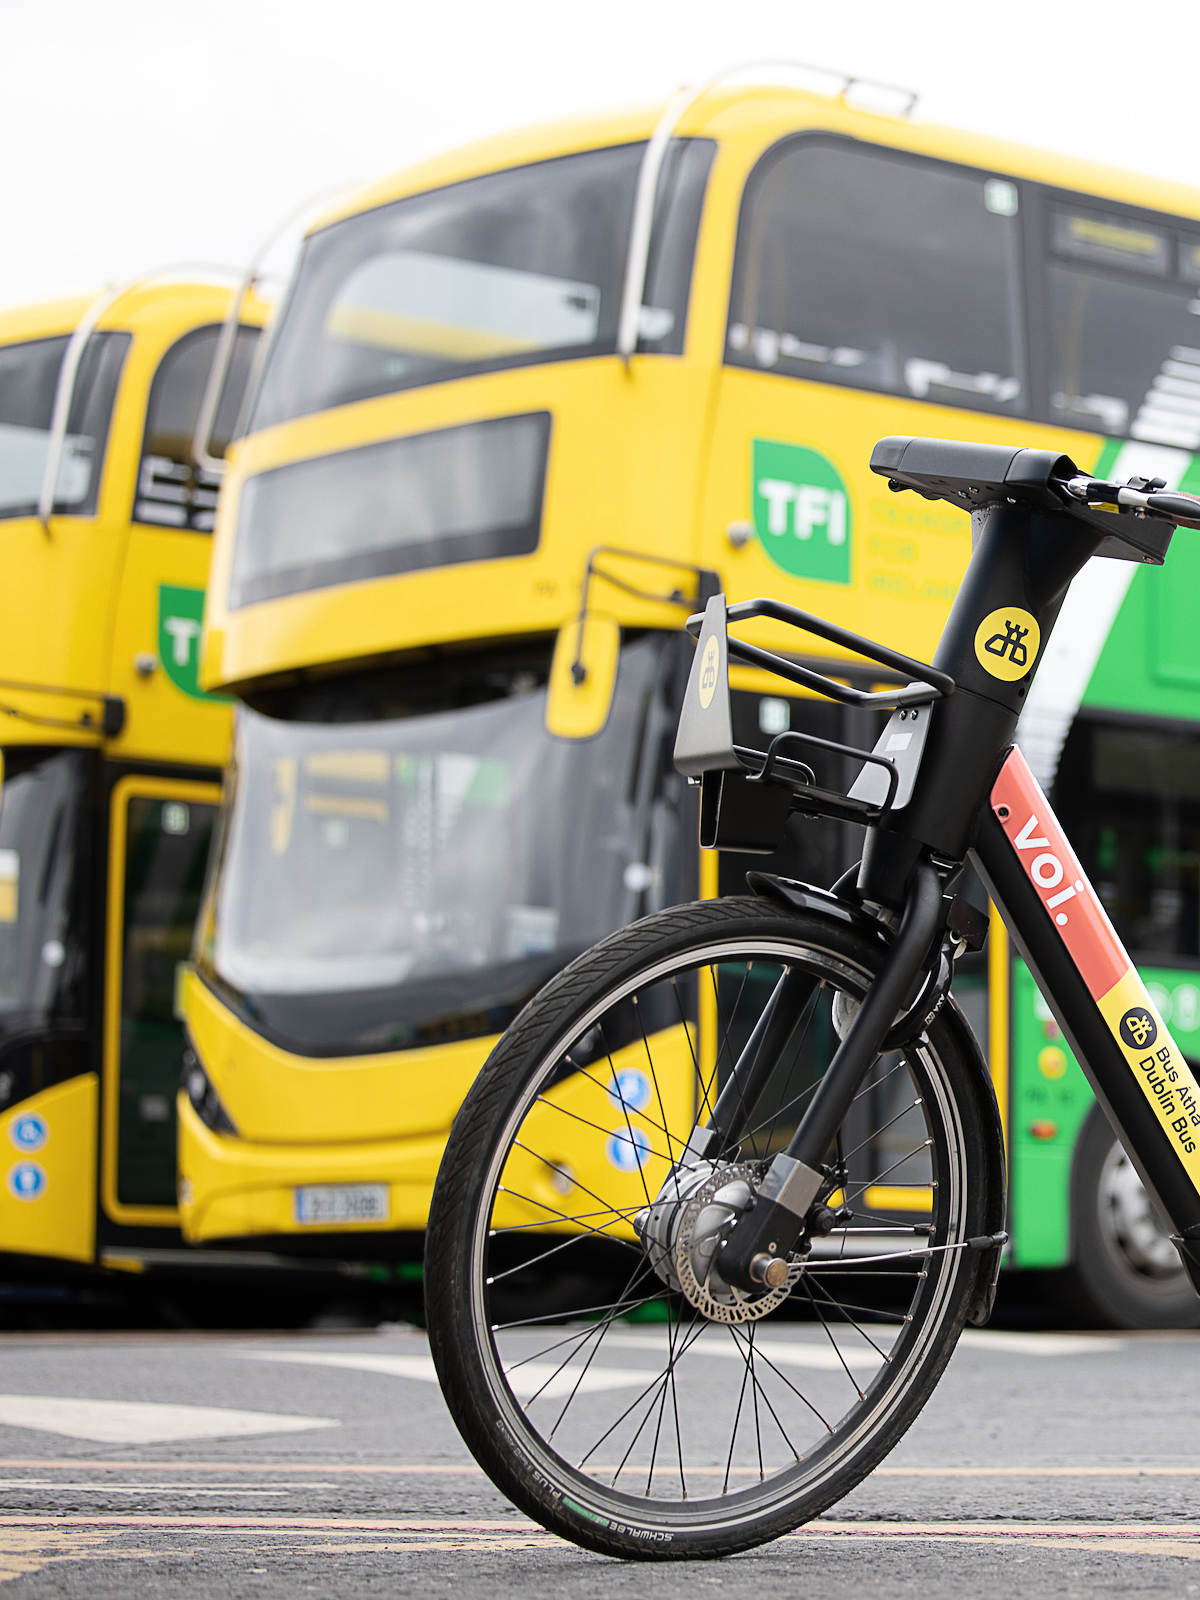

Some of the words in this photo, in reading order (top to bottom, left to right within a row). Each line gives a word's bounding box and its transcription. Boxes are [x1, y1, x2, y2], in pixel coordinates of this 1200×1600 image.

[758, 477, 846, 546] TFI
[1014, 814, 1084, 927] voi.
[932, 993, 945, 1012] AXA
[1156, 1046, 1179, 1083] Bus
[1139, 1056, 1176, 1116] Dublin
[1171, 1116, 1197, 1154] Bus
[532, 1471, 562, 1499] PLUS
[609, 1521, 674, 1542] SCHWALBE
